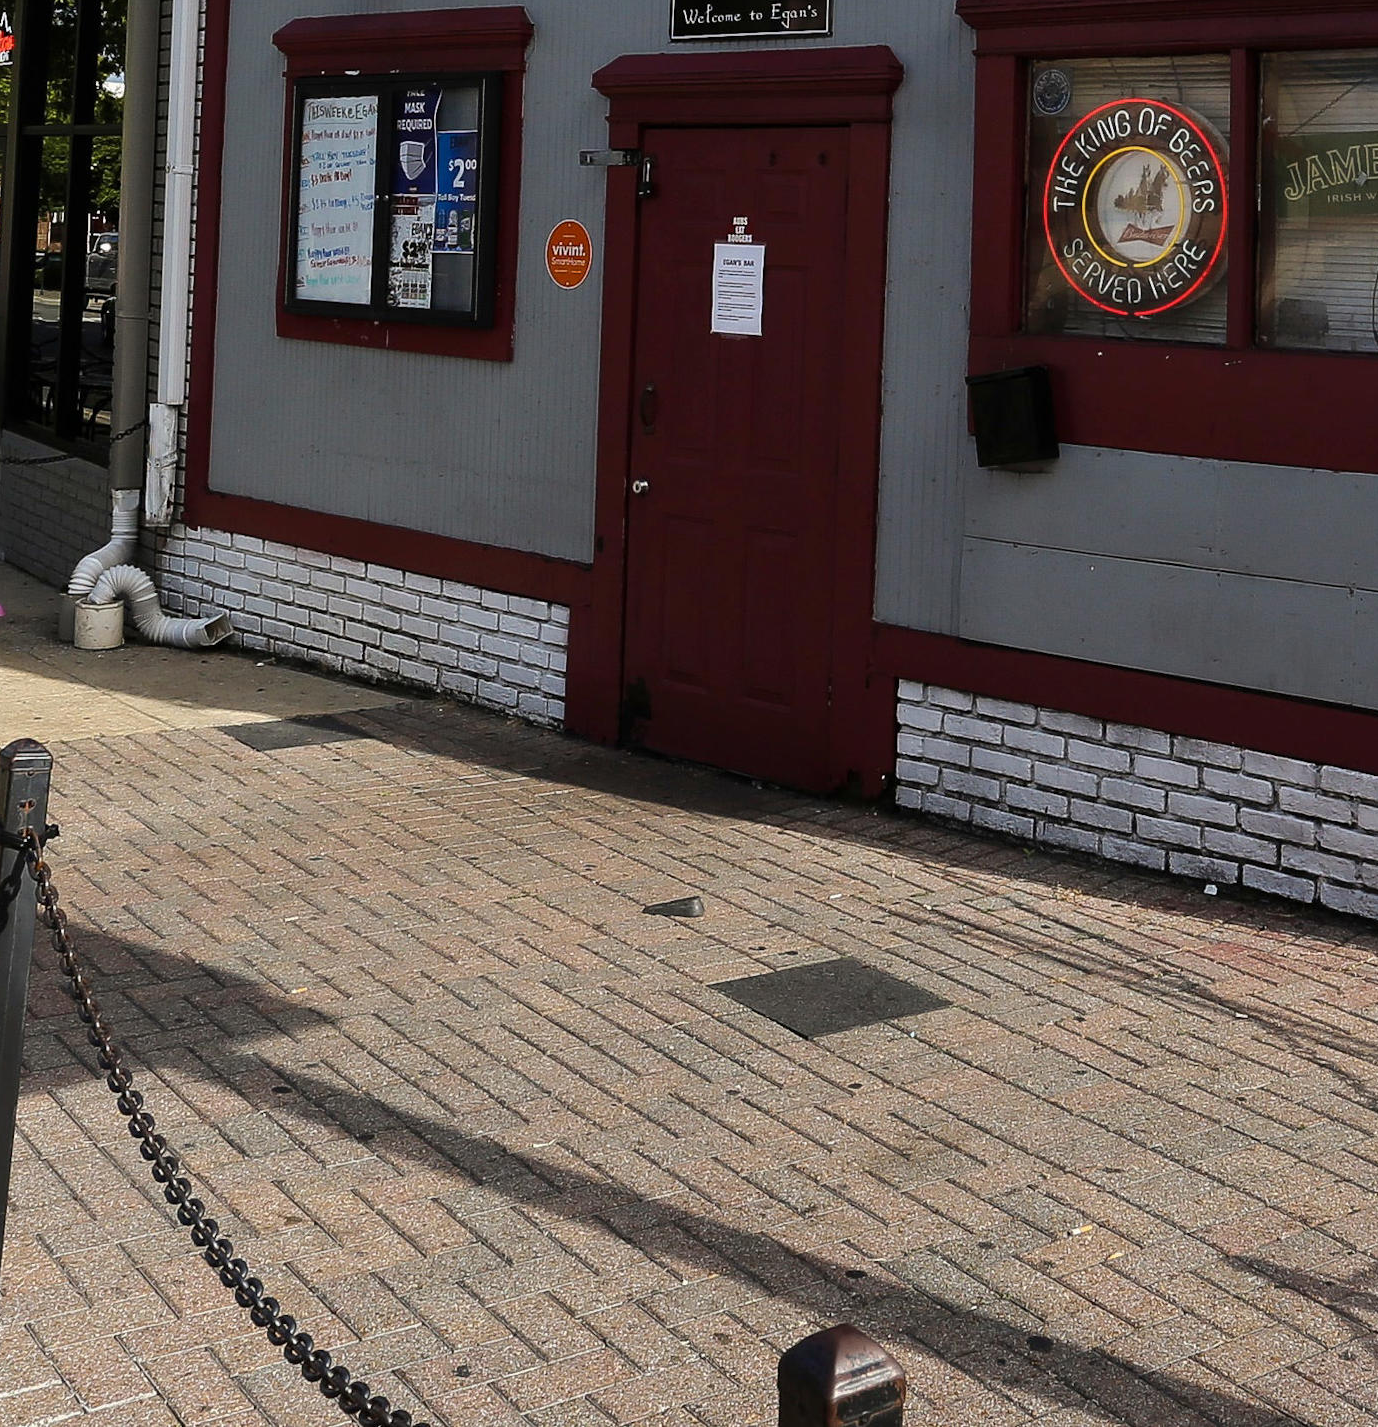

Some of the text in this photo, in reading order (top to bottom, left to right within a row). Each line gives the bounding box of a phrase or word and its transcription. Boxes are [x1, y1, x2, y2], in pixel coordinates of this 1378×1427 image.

[683, 3, 818, 28] Welcome to Egan's
[324, 105, 347, 119] WEEK
[404, 102, 426, 114] MASK
[397, 118, 433, 132] REQUIRED
[1054, 108, 1214, 214] THE KING OF BEERS
[1327, 192, 1362, 203] IRISH
[552, 241, 586, 256] vivint.
[1063, 238, 1206, 304] SERVED HERE
